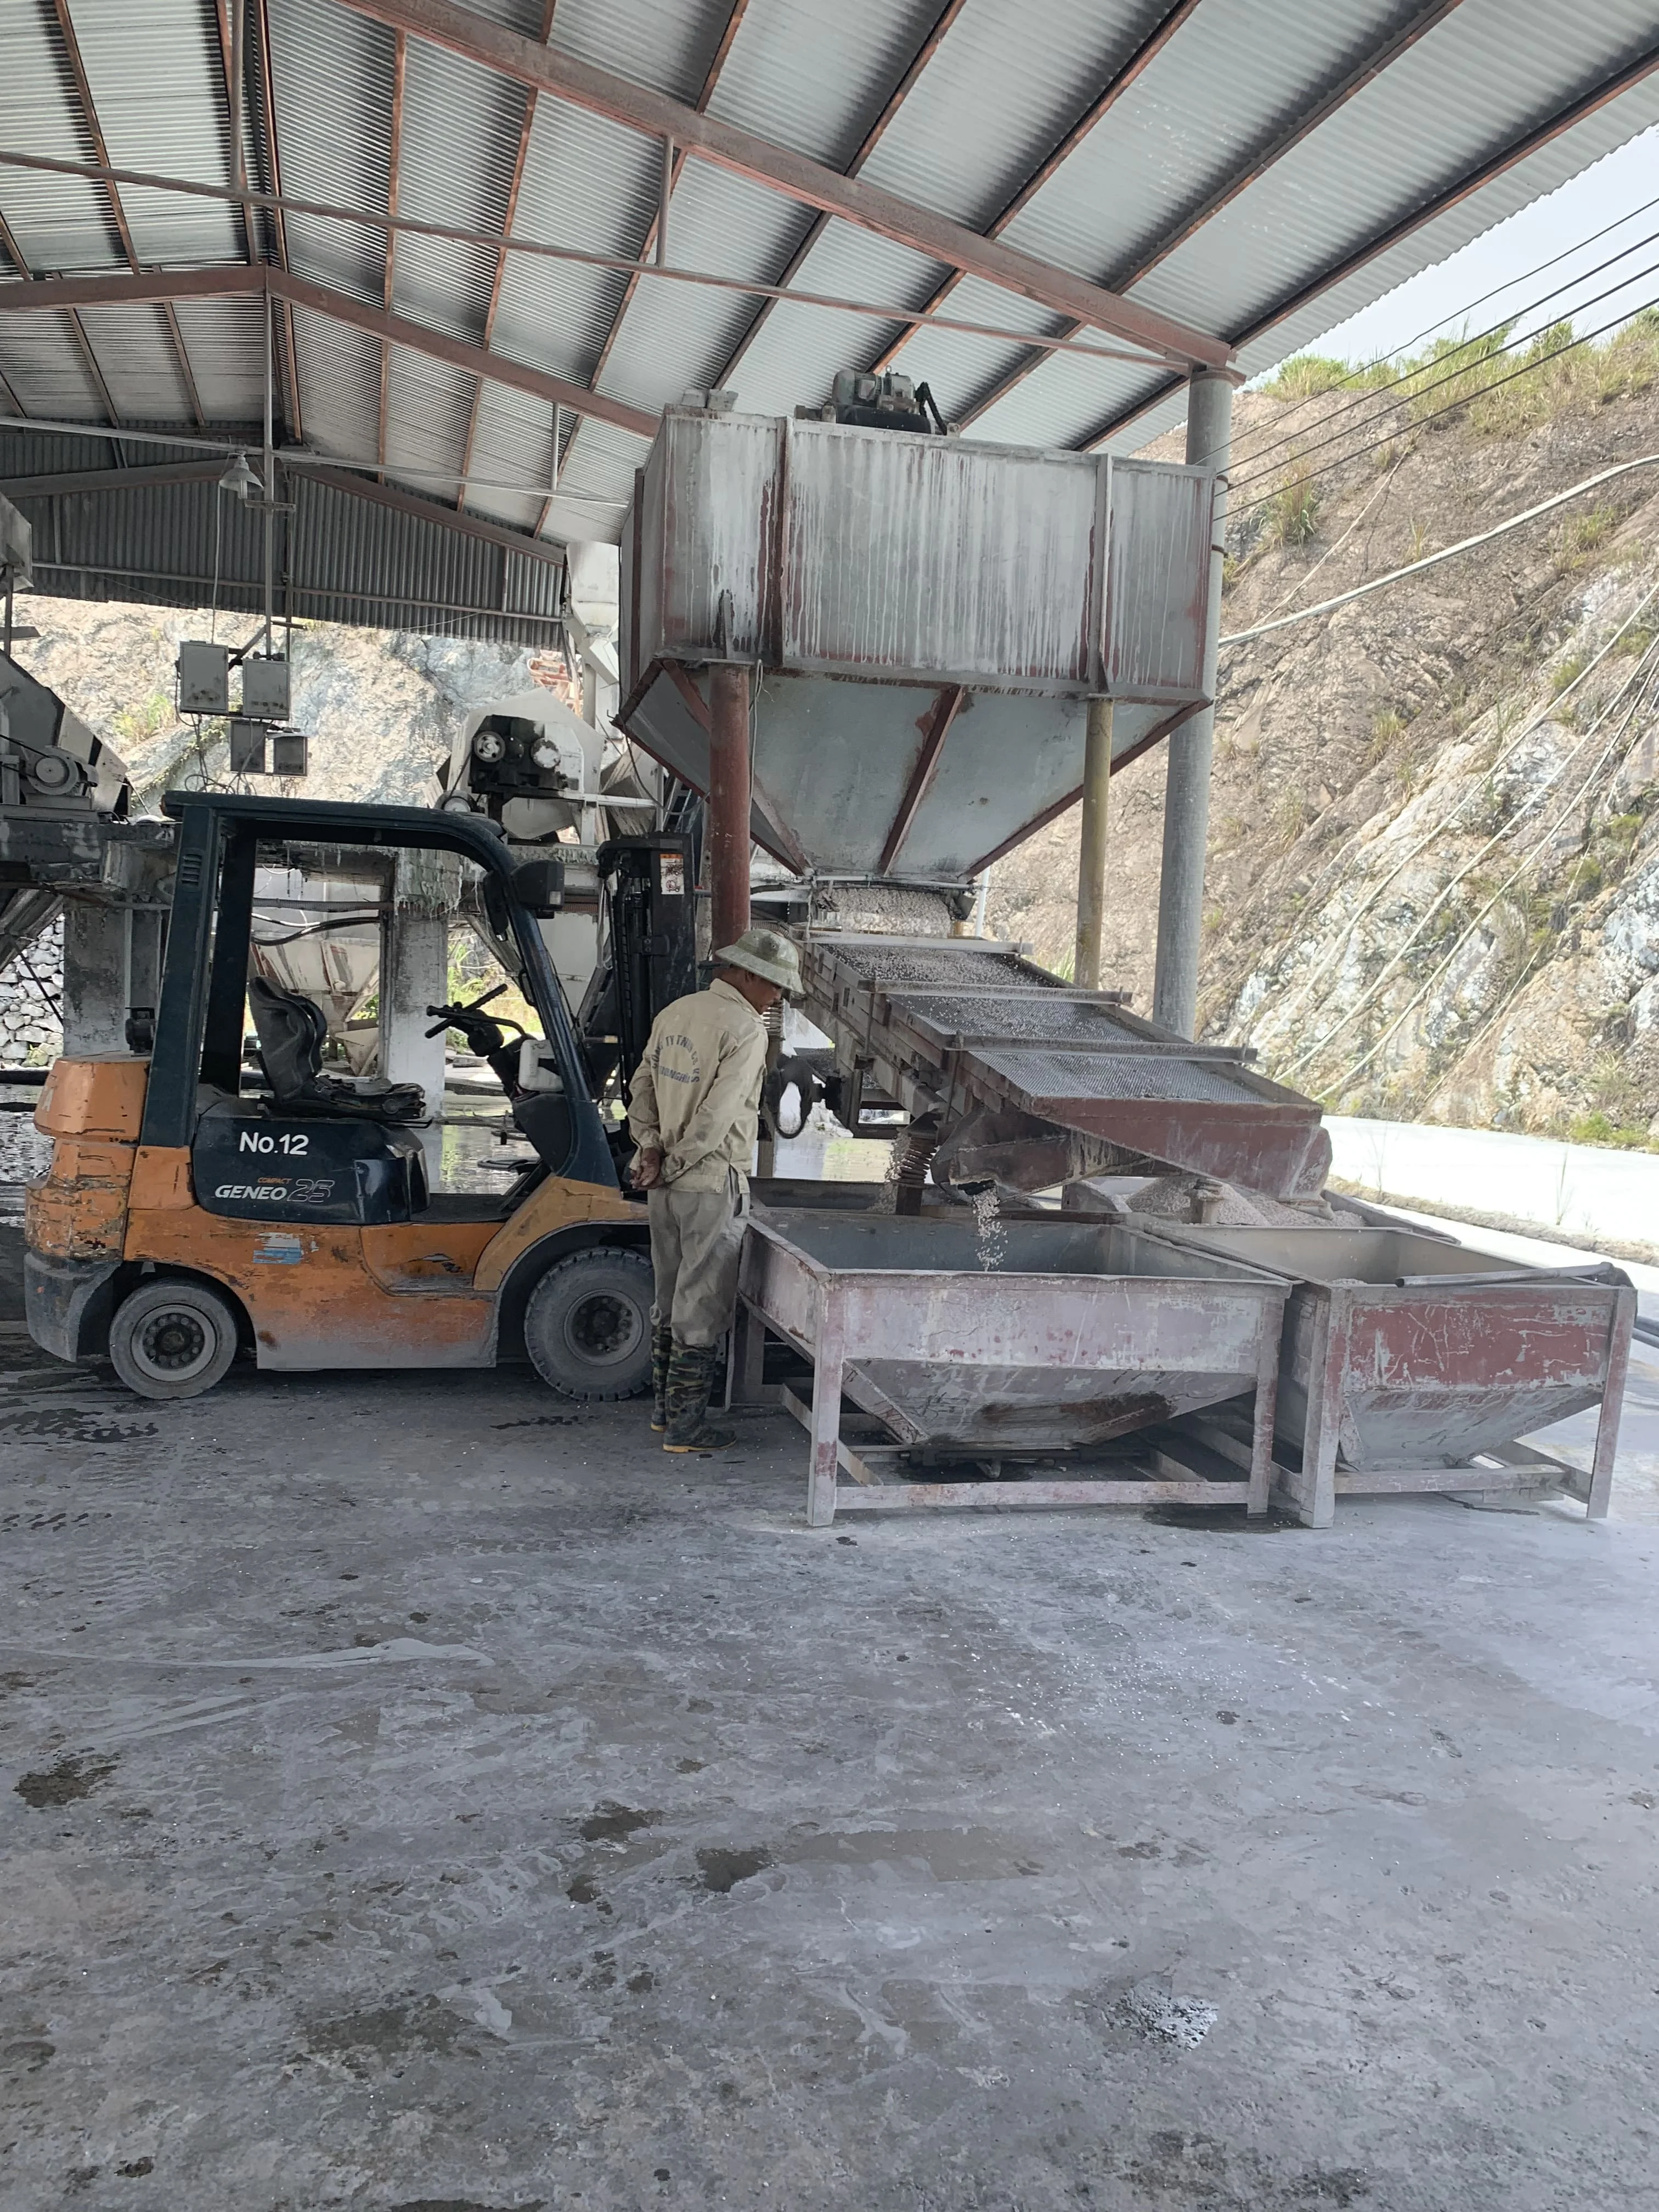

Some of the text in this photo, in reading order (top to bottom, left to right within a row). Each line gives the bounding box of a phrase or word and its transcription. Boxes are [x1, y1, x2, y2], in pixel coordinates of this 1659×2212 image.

[665, 1035, 674, 1047] TY
[239, 1131, 309, 1156] No.12
[215, 1178, 335, 1203] GENEO 25
